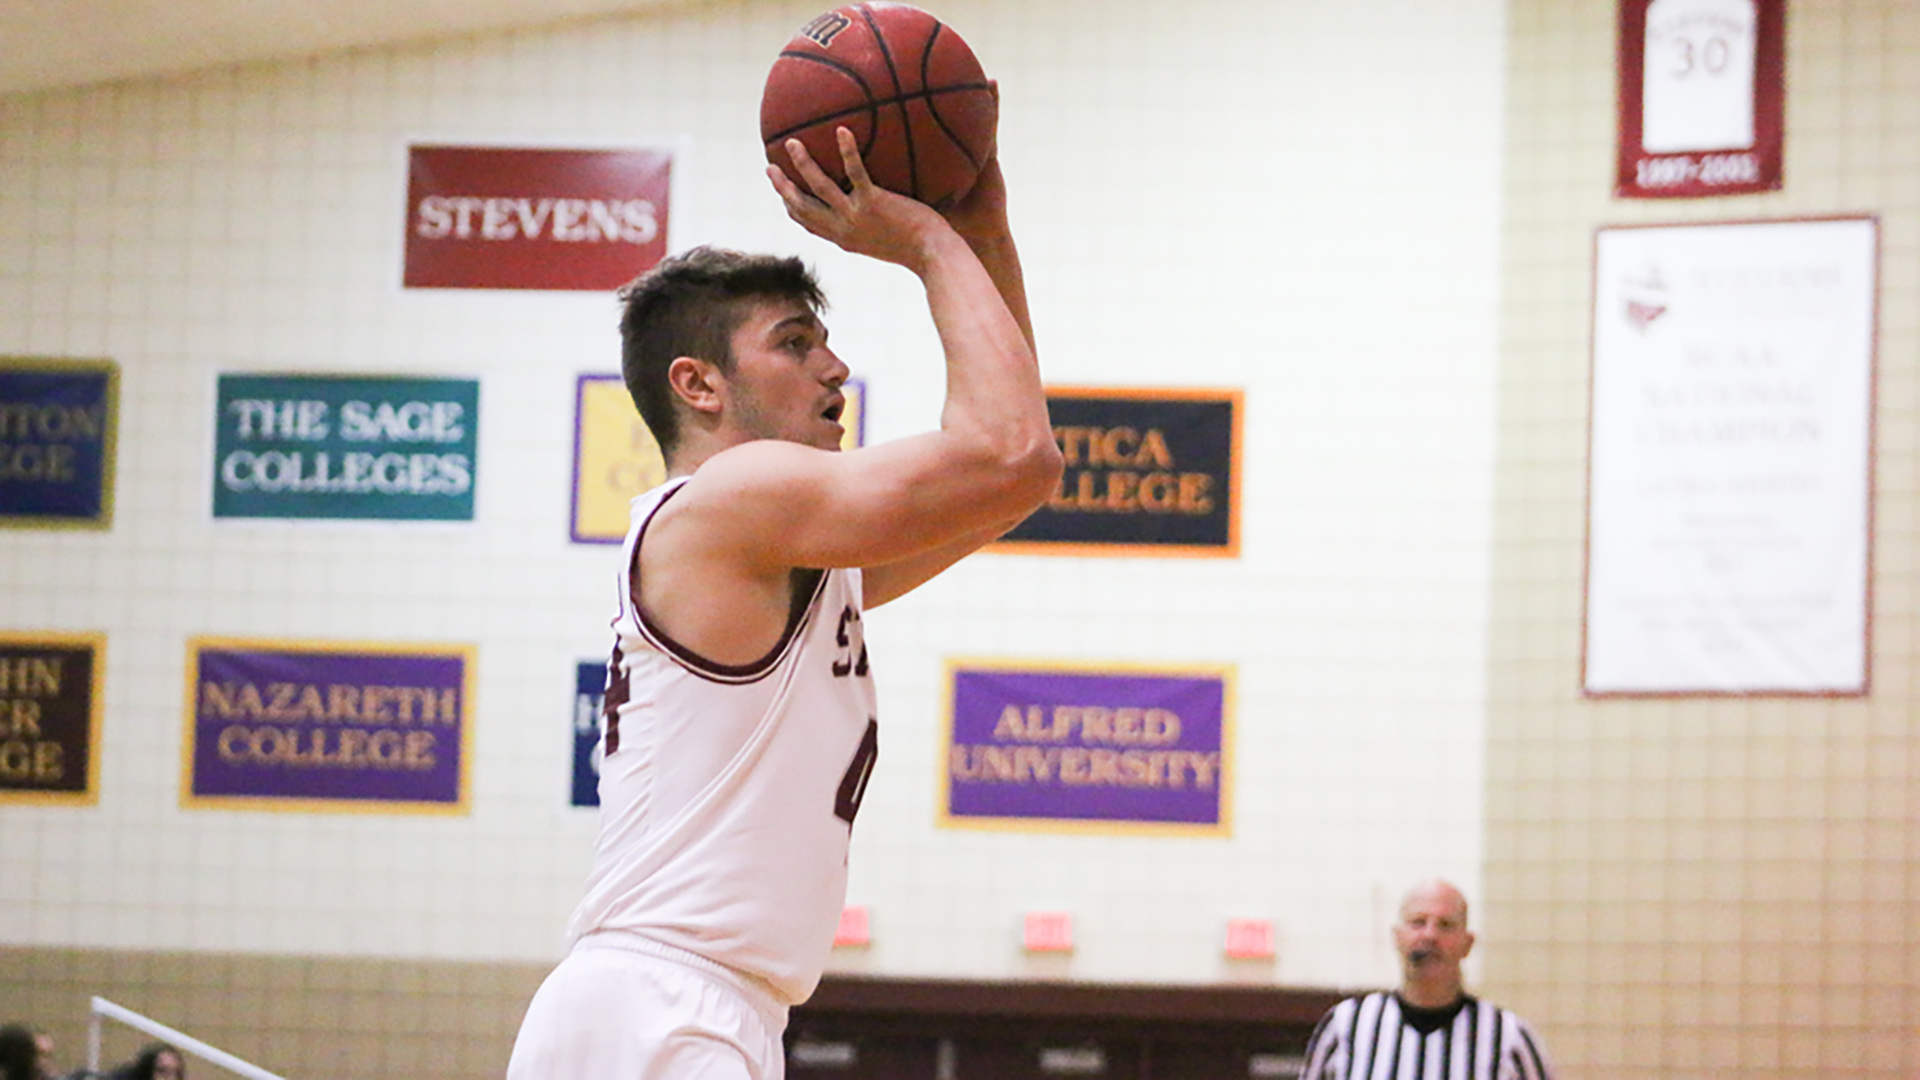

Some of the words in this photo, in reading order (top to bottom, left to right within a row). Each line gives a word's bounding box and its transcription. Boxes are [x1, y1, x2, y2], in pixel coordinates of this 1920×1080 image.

[1669, 35, 1729, 80] 30
[417, 195, 658, 244] STEVENS
[234, 399, 329, 441] THE
[340, 399, 465, 443] SAGE
[221, 450, 471, 495] COLLEGES
[203, 681, 458, 726] NAZARETH
[993, 703, 1182, 746] ALFRED
[217, 726, 438, 772] COLLEGE
[949, 744, 1221, 789] UNIVERSITY
